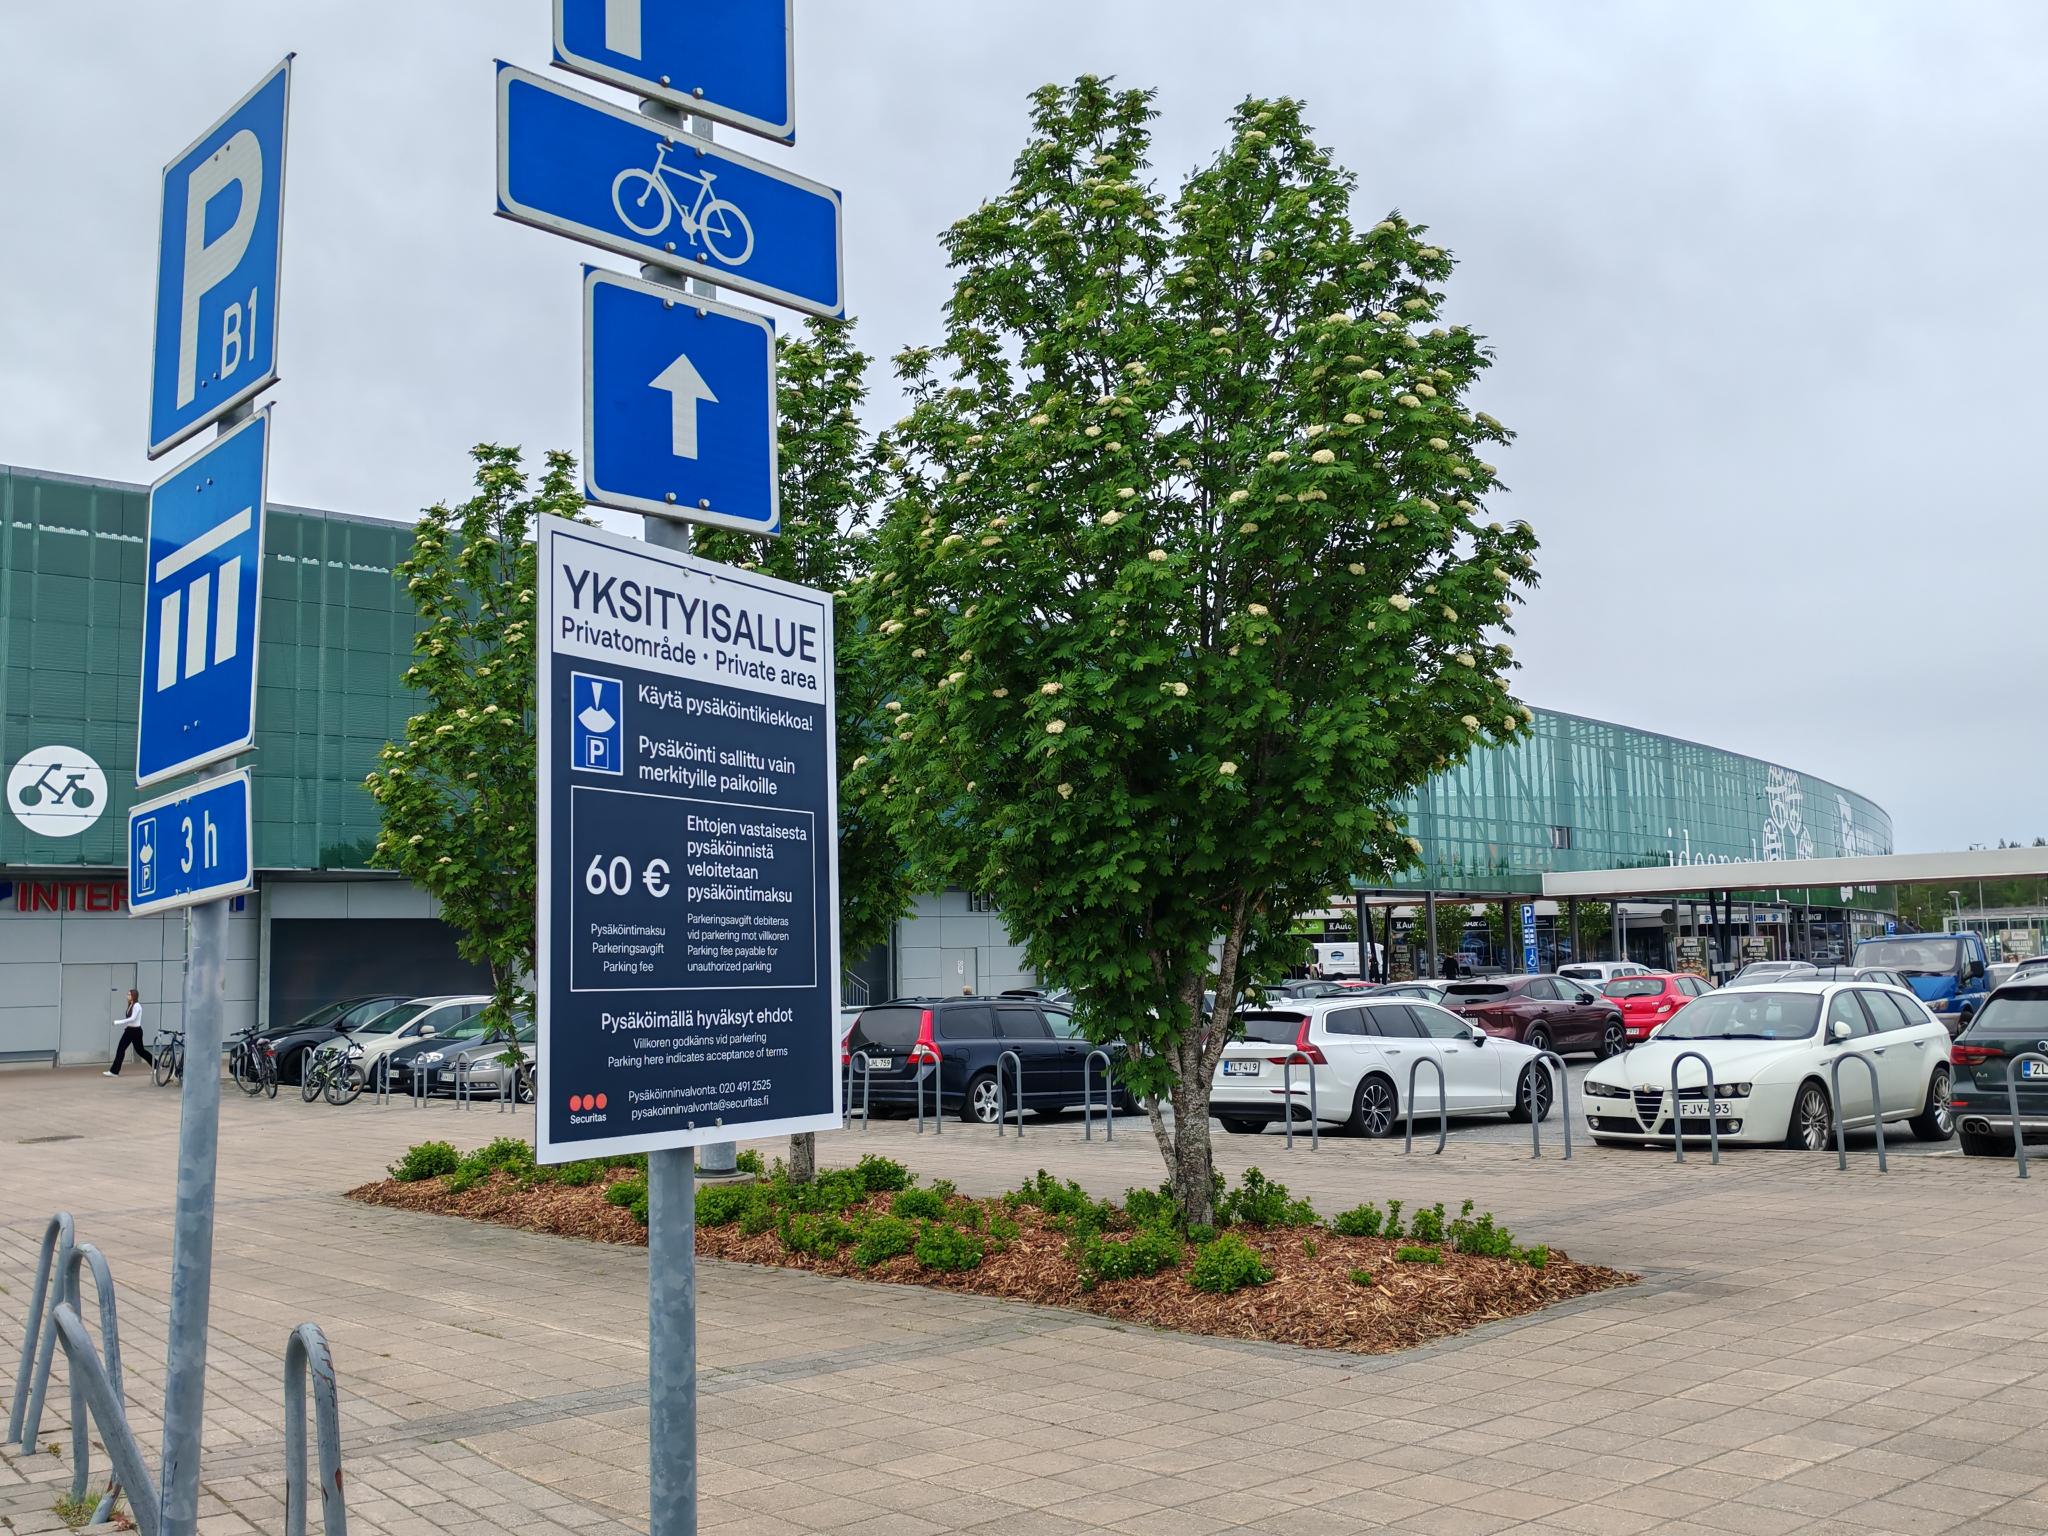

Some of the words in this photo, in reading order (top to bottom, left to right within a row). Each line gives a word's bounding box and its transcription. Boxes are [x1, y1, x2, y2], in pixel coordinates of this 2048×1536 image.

[177, 129, 263, 411] P
[221, 286, 258, 380] B1
[563, 564, 817, 663] YKSITYISALUE
[562, 616, 696, 666] Privatområde
[716, 650, 776, 682] Private
[781, 669, 817, 691] area
[639, 684, 683, 710] Käytä
[686, 697, 813, 732] pysäköintikiekkoa!
[639, 735, 716, 764] Pysäköinti
[719, 750, 765, 770] sallittu
[768, 757, 796, 775] vain
[639, 765, 717, 789] merkityille
[720, 774, 778, 795] paikoille
[687, 815, 737, 837] Ehtojen
[739, 823, 807, 841] vastaisesta
[181, 816, 194, 874] 3
[204, 810, 218, 869] h
[687, 839, 775, 860] pysäköinnistä
[586, 854, 632, 896] 60
[642, 858, 671, 898] €
[687, 861, 759, 880] veloitetaan
[687, 883, 793, 903] pysäköintimaksu
[591, 923, 666, 938] Pysäköintimaksu
[687, 913, 752, 927] Parkeringsavgift
[753, 915, 789, 926] debiteras
[687, 929, 700, 940] vid
[701, 930, 740, 943] parkering
[741, 931, 757, 940] mot
[758, 930, 790, 941] villkoren
[592, 942, 665, 956] Parkeringsavgift
[687, 945, 719, 958] Parking
[720, 945, 734, 956] fee
[735, 946, 766, 958] payable
[767, 946, 778, 956] for
[603, 961, 638, 975] Parking
[639, 961, 654, 972] fee
[687, 961, 741, 972] unauthorized
[742, 961, 772, 974] parking
[601, 1010, 694, 1033] Pysäköimällä
[697, 1008, 754, 1029] hyväksyt
[756, 1007, 793, 1023] ehdot
[633, 1037, 671, 1049] Villkoren
[672, 1034, 715, 1050] godkänns
[715, 1033, 728, 1045] vid
[729, 1032, 767, 1046] parkering
[608, 1056, 642, 1068] Parking
[644, 1054, 664, 1065] here
[666, 1051, 705, 1064] indicates
[706, 1049, 755, 1061] acceptance
[756, 1048, 765, 1058] of
[766, 1046, 789, 1057] terms
[628, 1085, 718, 1104] Pysäköinninvalvonta:
[719, 1082, 736, 1094] 020
[736, 1081, 751, 1093] 491
[752, 1079, 772, 1091] 2525
[570, 1112, 607, 1124] Securitas
[631, 1095, 769, 1121] pysakoinninvalvonta@securitas.fi
[1682, 1103, 1730, 1115] FJV-93
